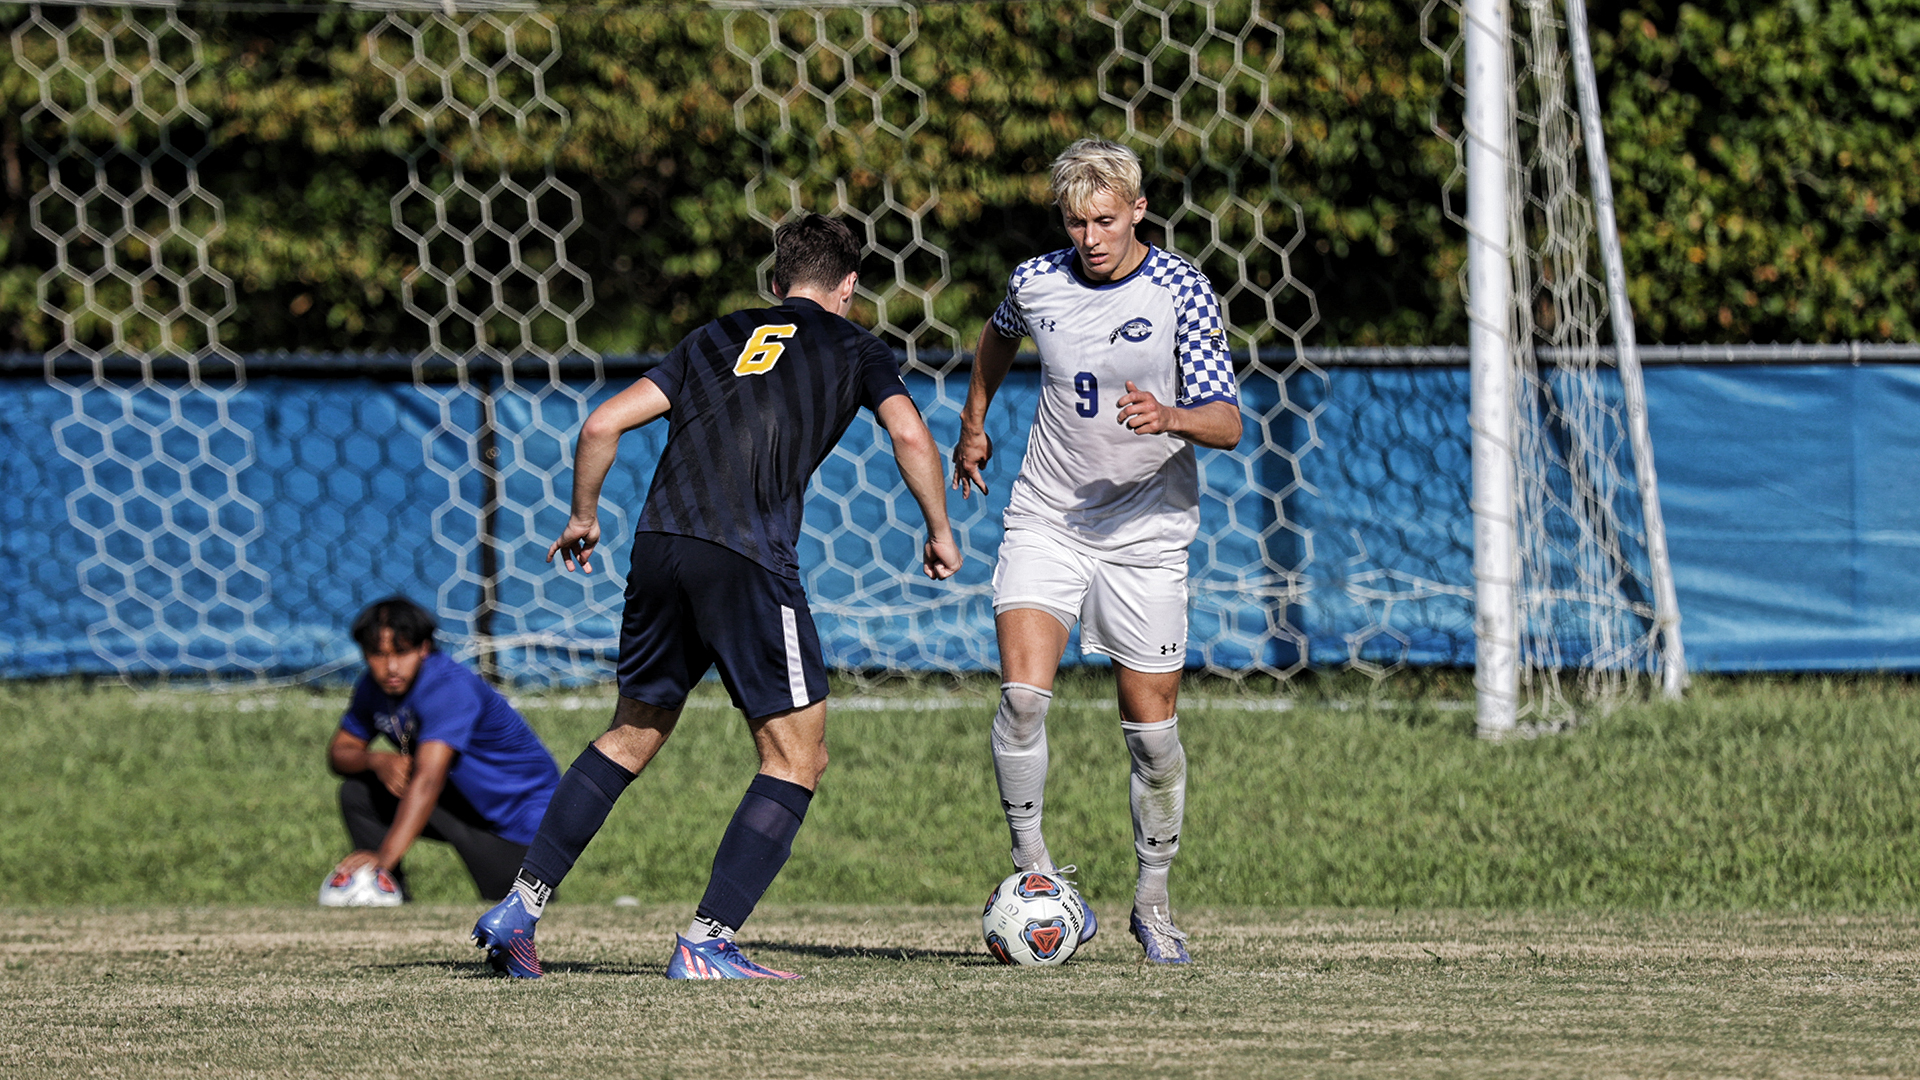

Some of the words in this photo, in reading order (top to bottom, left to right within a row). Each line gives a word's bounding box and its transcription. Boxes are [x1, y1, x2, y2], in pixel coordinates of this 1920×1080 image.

[733, 323, 797, 376] 6
[1074, 371, 1099, 418] 9
[1061, 901, 1080, 933] Wilson
